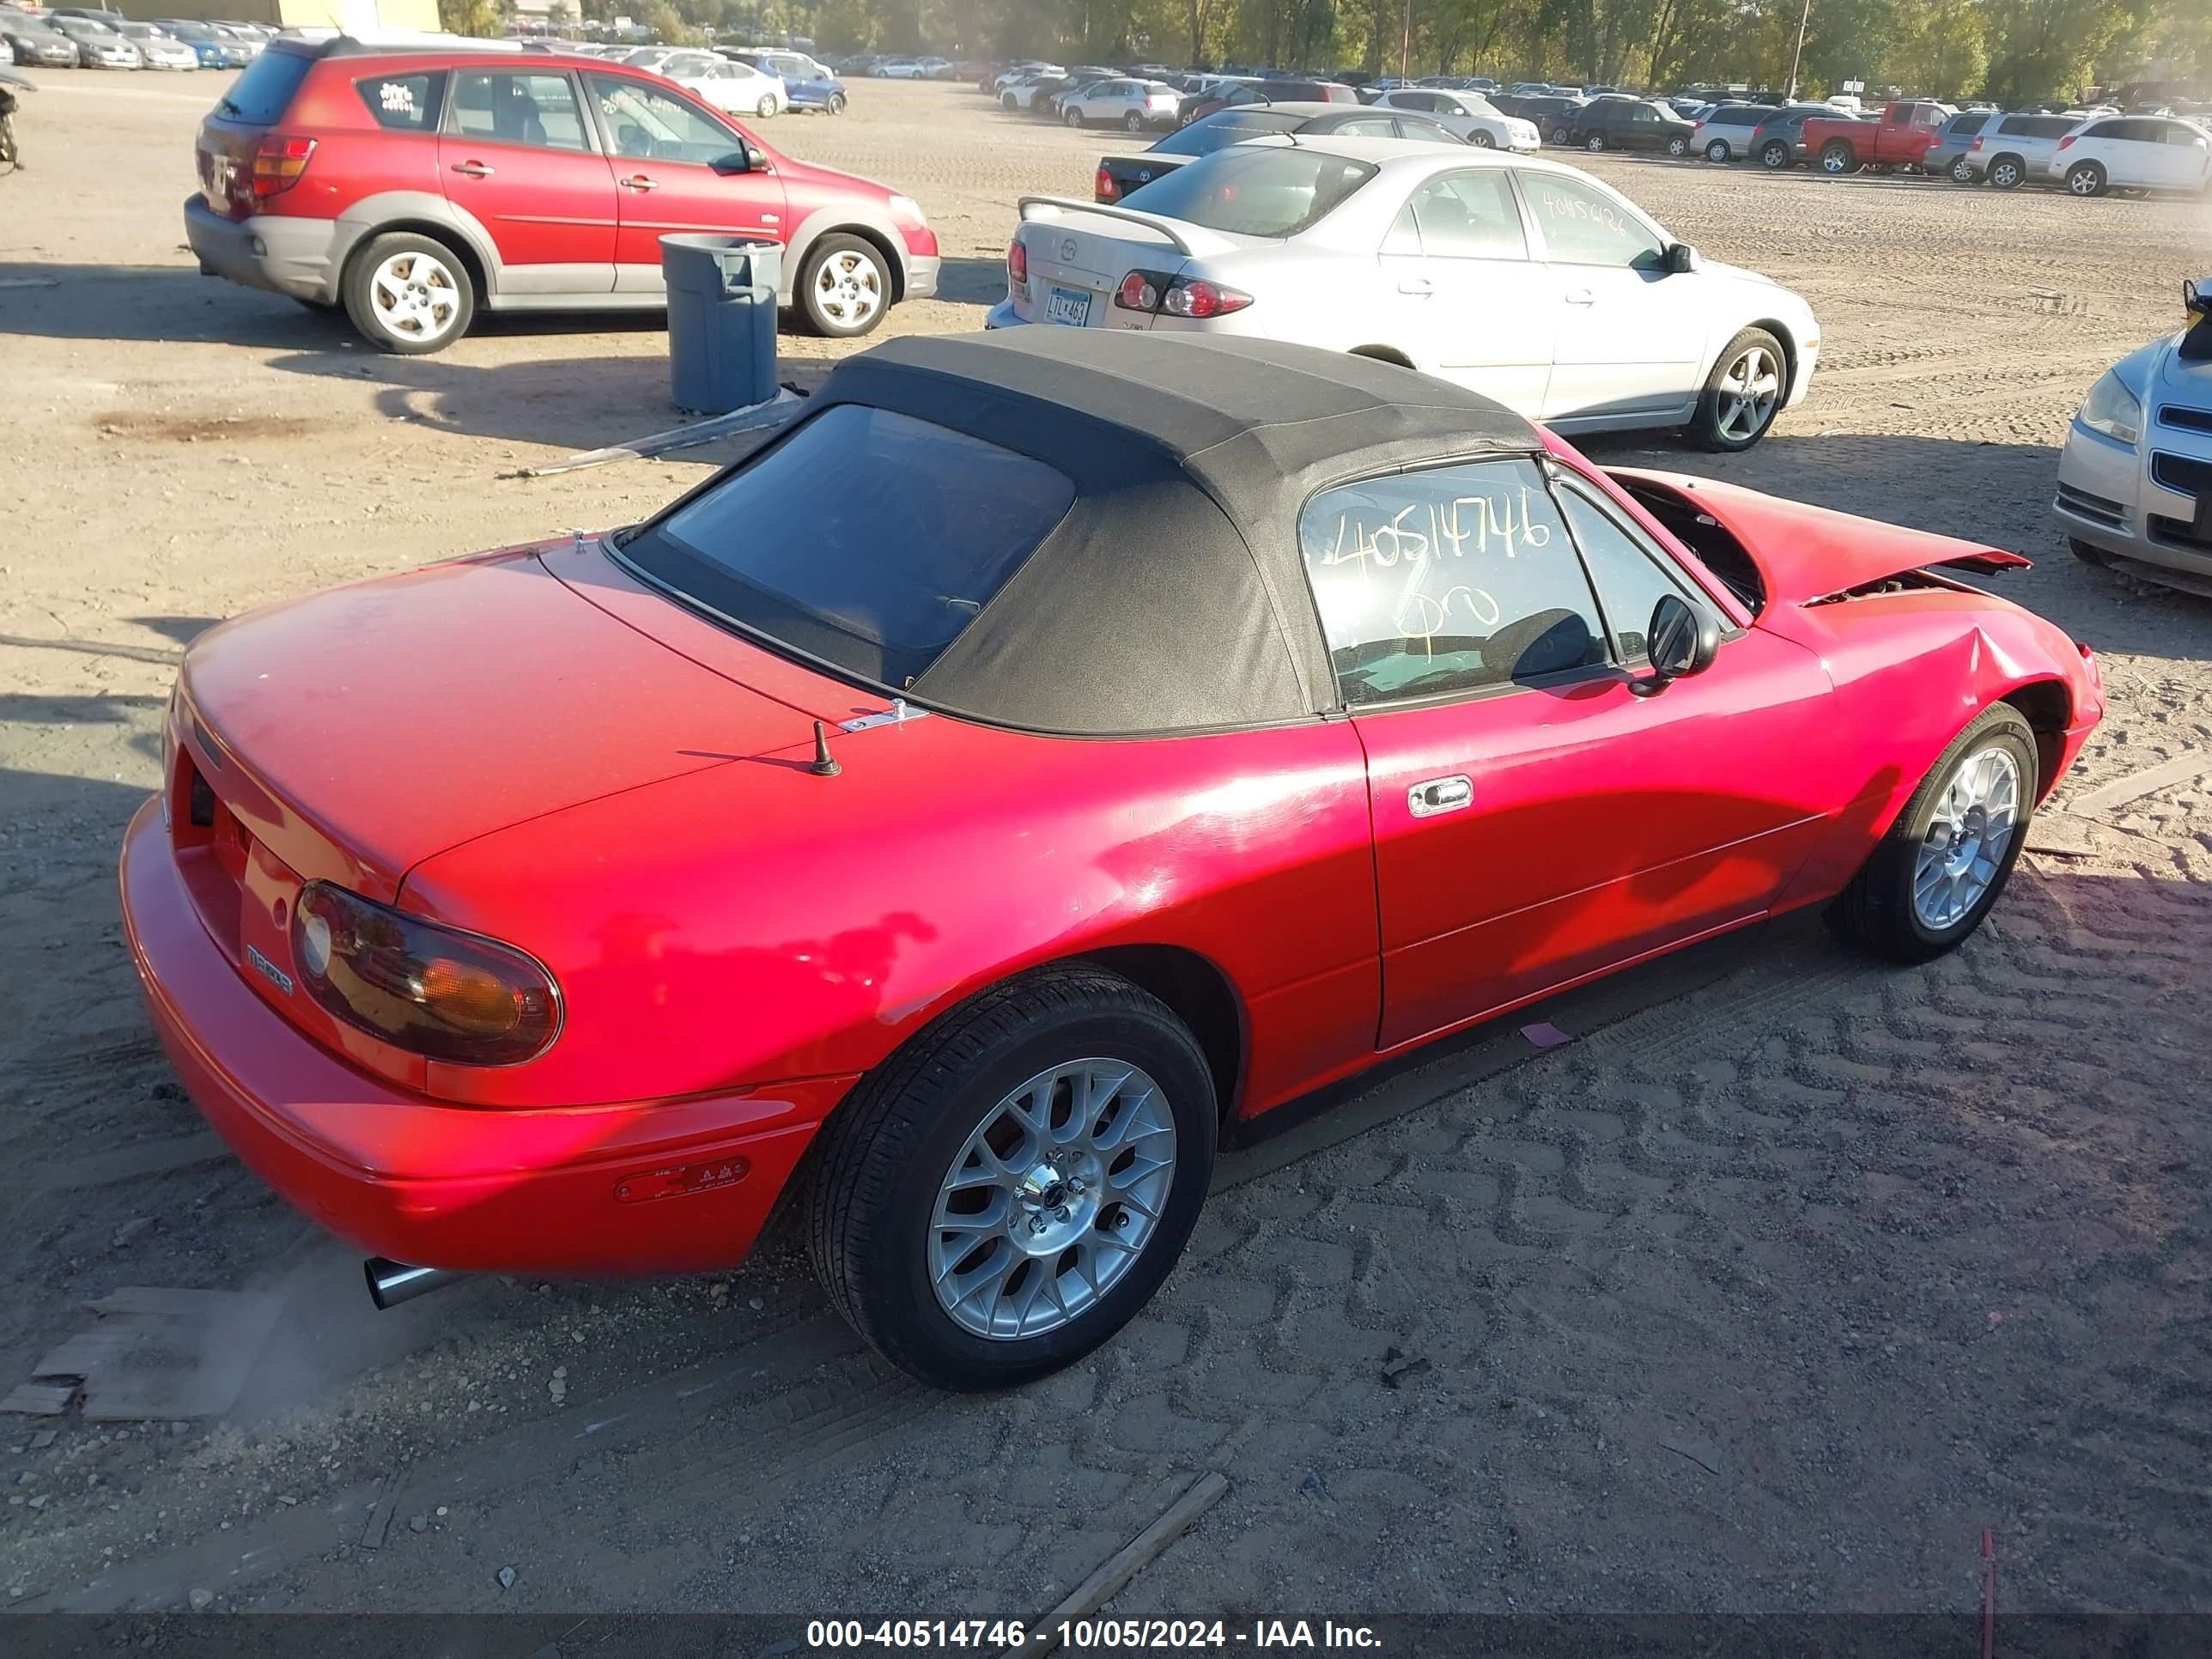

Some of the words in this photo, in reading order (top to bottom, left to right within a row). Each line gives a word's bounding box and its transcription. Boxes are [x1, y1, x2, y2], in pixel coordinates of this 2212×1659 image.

[1047, 295, 1064, 316] LTL
[1068, 301, 1085, 320] 463
[1325, 487, 1550, 579] 40514746
